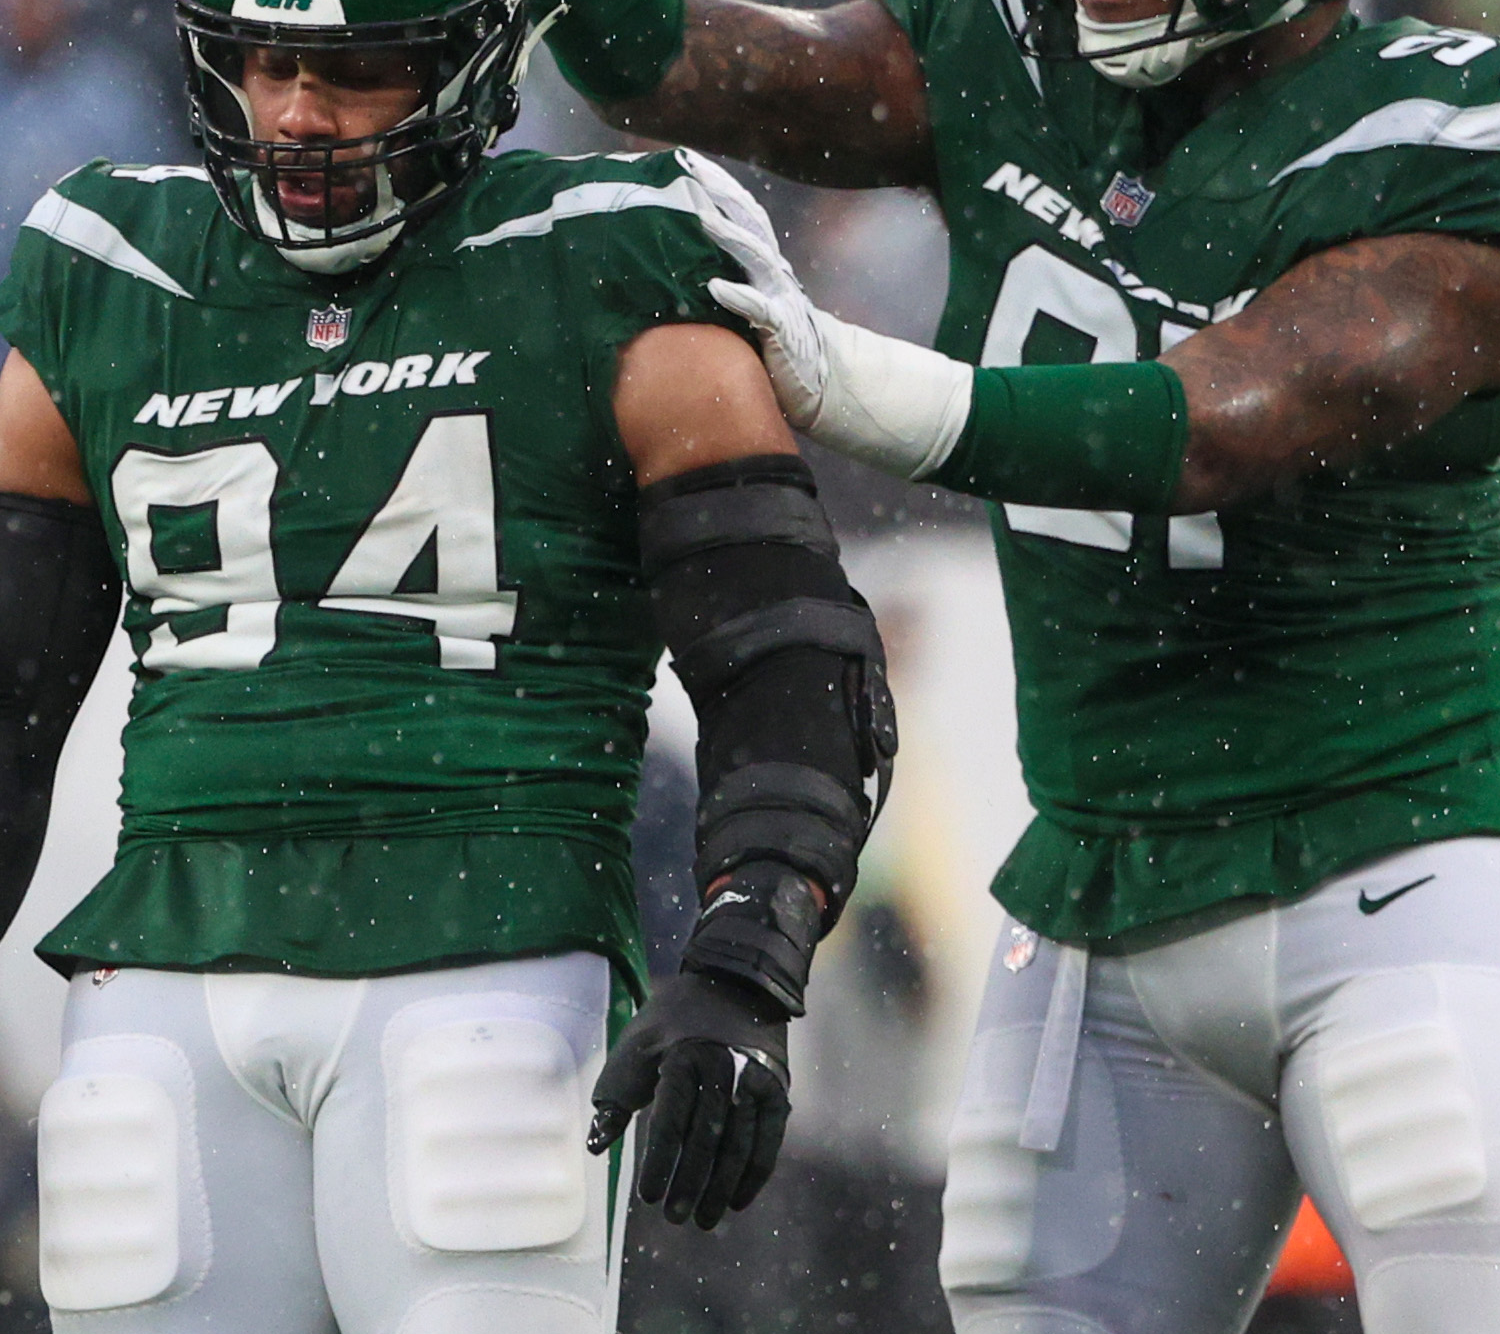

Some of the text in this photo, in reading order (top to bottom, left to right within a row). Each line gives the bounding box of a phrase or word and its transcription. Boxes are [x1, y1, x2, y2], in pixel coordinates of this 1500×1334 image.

[982, 162, 1105, 251] NEW
[315, 323, 345, 342] NFL
[133, 351, 491, 428] NEW YORK
[110, 409, 519, 670] 94
